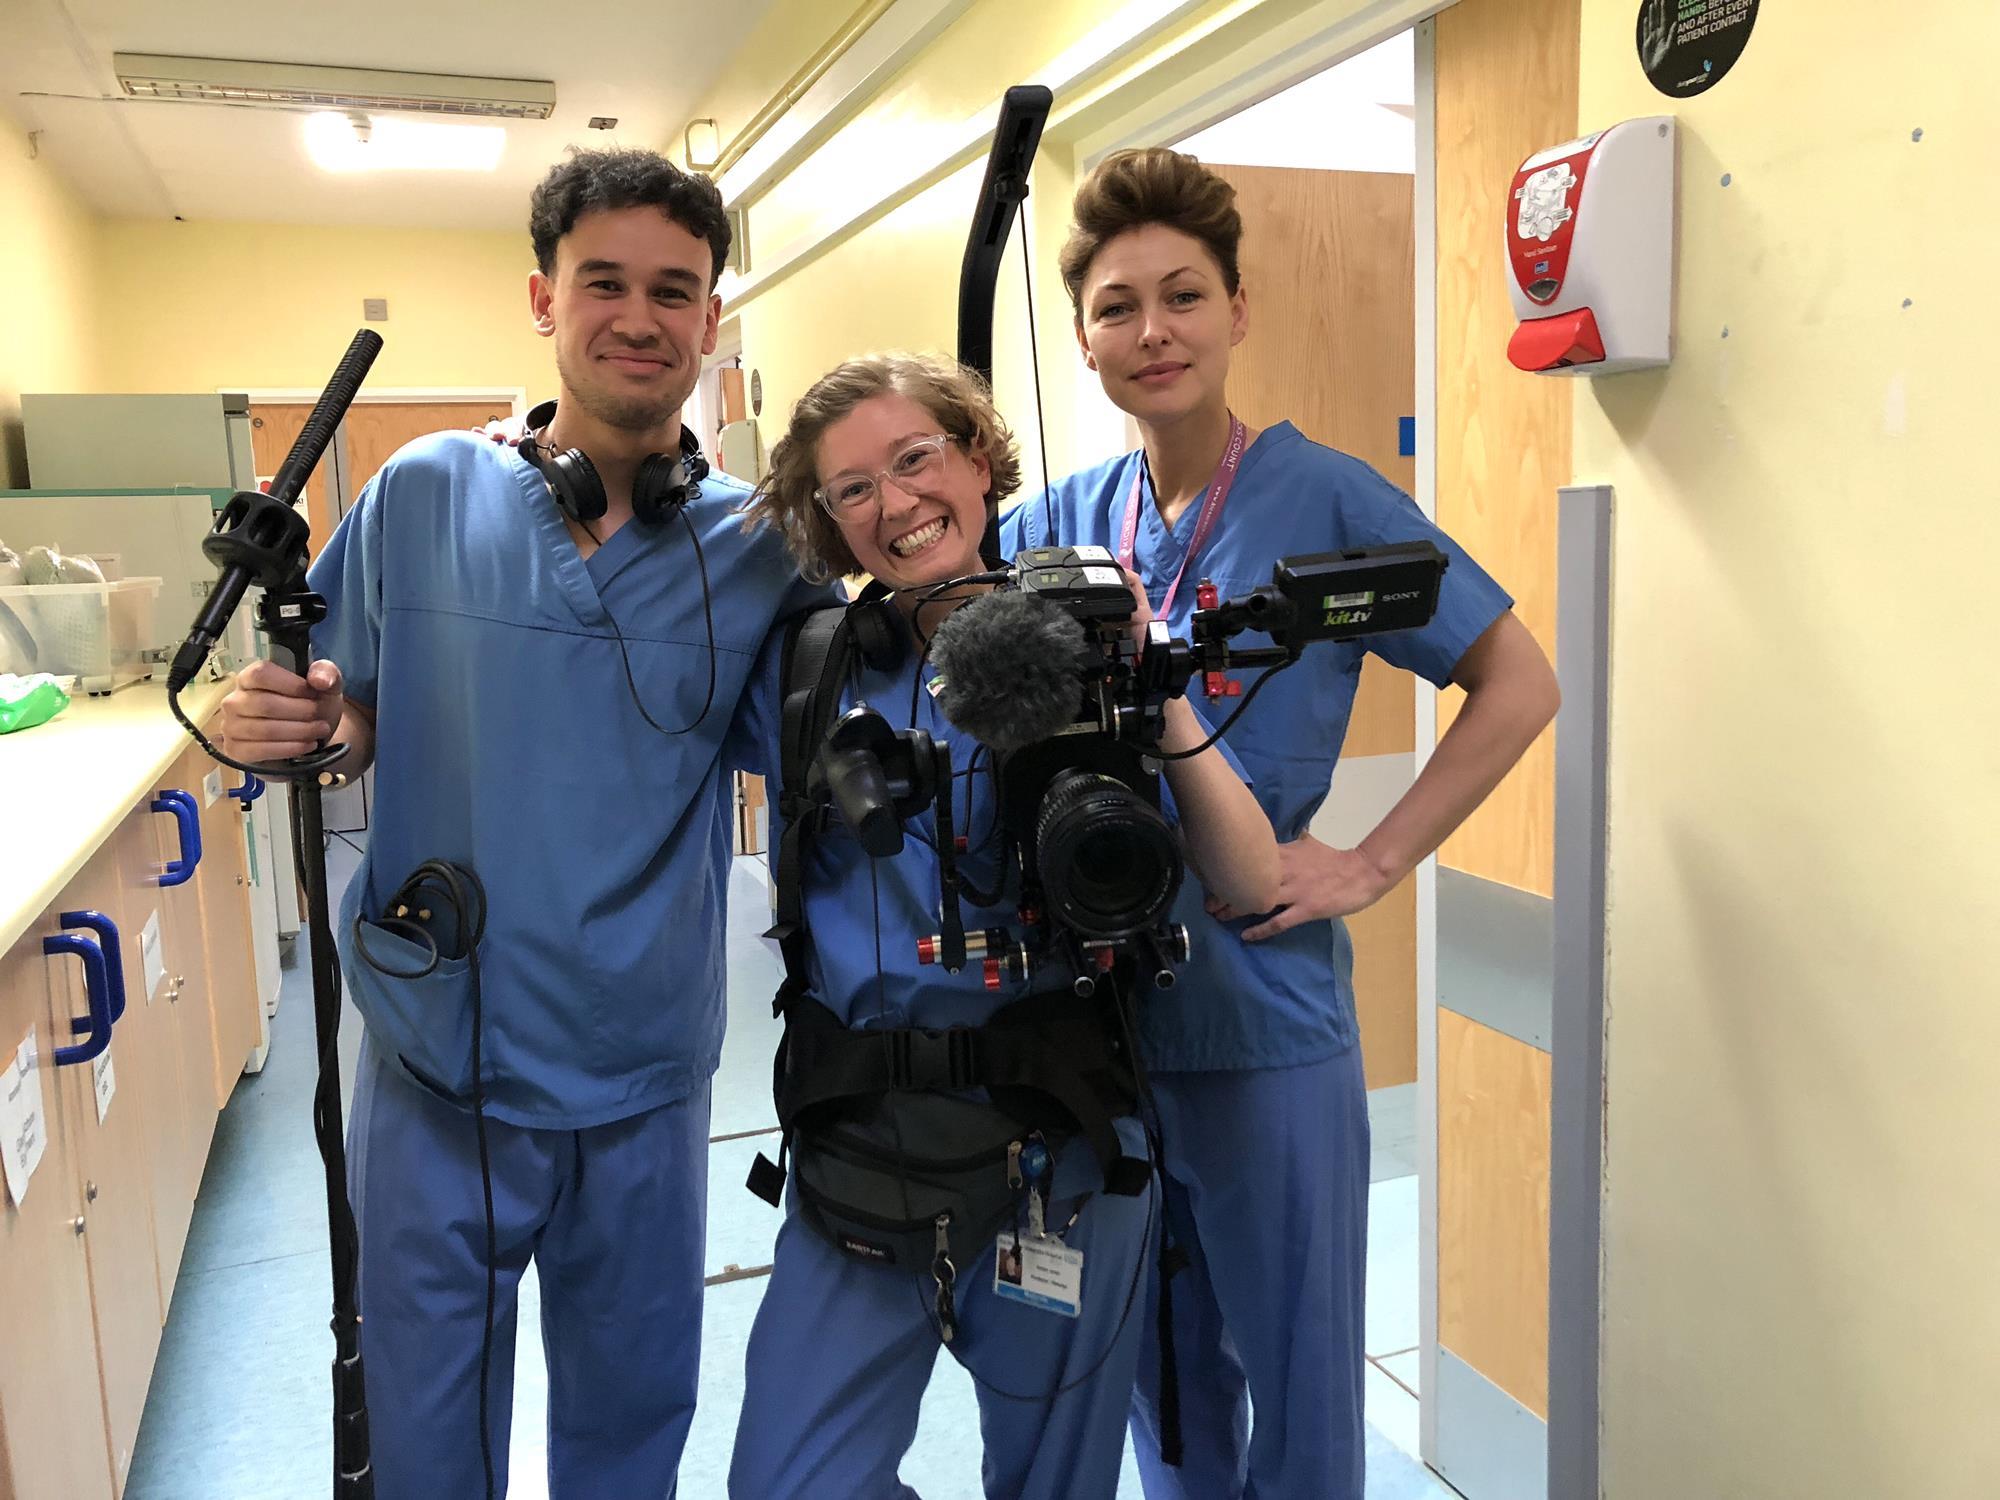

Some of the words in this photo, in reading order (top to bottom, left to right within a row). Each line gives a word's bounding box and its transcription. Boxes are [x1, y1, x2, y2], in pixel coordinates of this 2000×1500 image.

[1677, 18, 1696, 33] AND
[1697, 6, 1724, 26] AFTER
[1678, 2, 1706, 21] HANDS
[1677, 24, 1709, 46] PATIENT
[1710, 10, 1748, 32] CONTACT
[1226, 437, 1242, 472] COUNT
[1382, 590, 1420, 601] SONY
